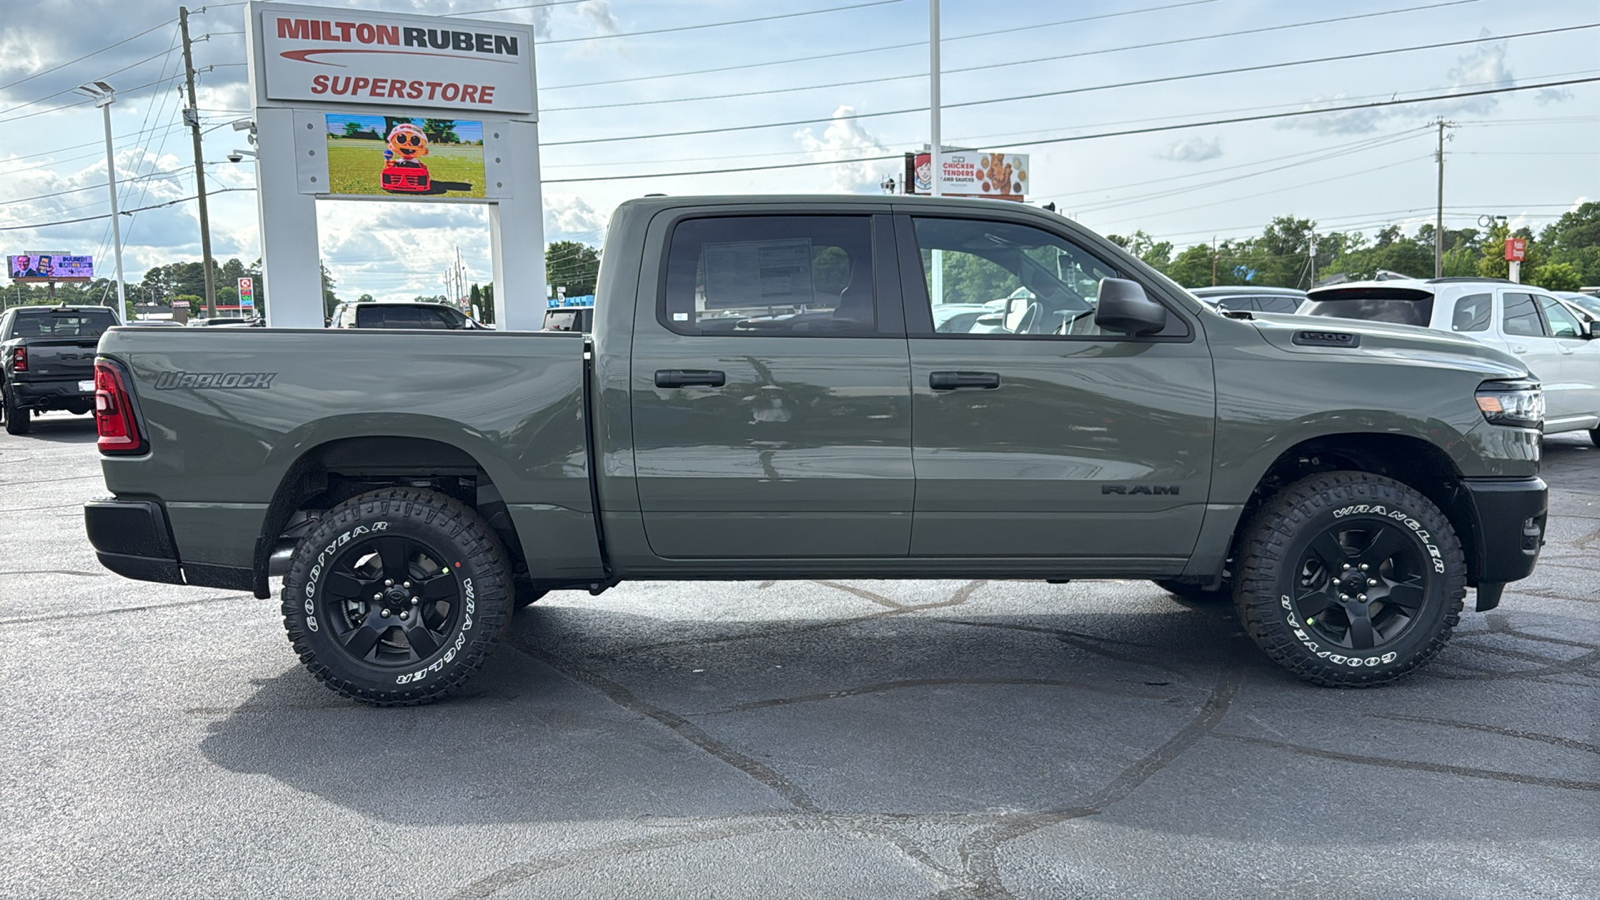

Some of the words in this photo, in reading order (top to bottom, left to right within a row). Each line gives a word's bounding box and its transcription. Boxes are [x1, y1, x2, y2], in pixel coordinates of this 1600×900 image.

[277, 18, 400, 46] MILTON
[403, 27, 518, 56] RUBEN
[311, 75, 495, 104] SUPERSTORE
[1301, 332, 1353, 341] 1500
[154, 371, 278, 390] WARLOCK
[1101, 485, 1179, 495] RAM
[1333, 504, 1444, 574] WRANGLER
[305, 521, 389, 633] GOODYEAR
[396, 578, 475, 685] WRANGLER
[1281, 594, 1397, 667] GOODYEAR
